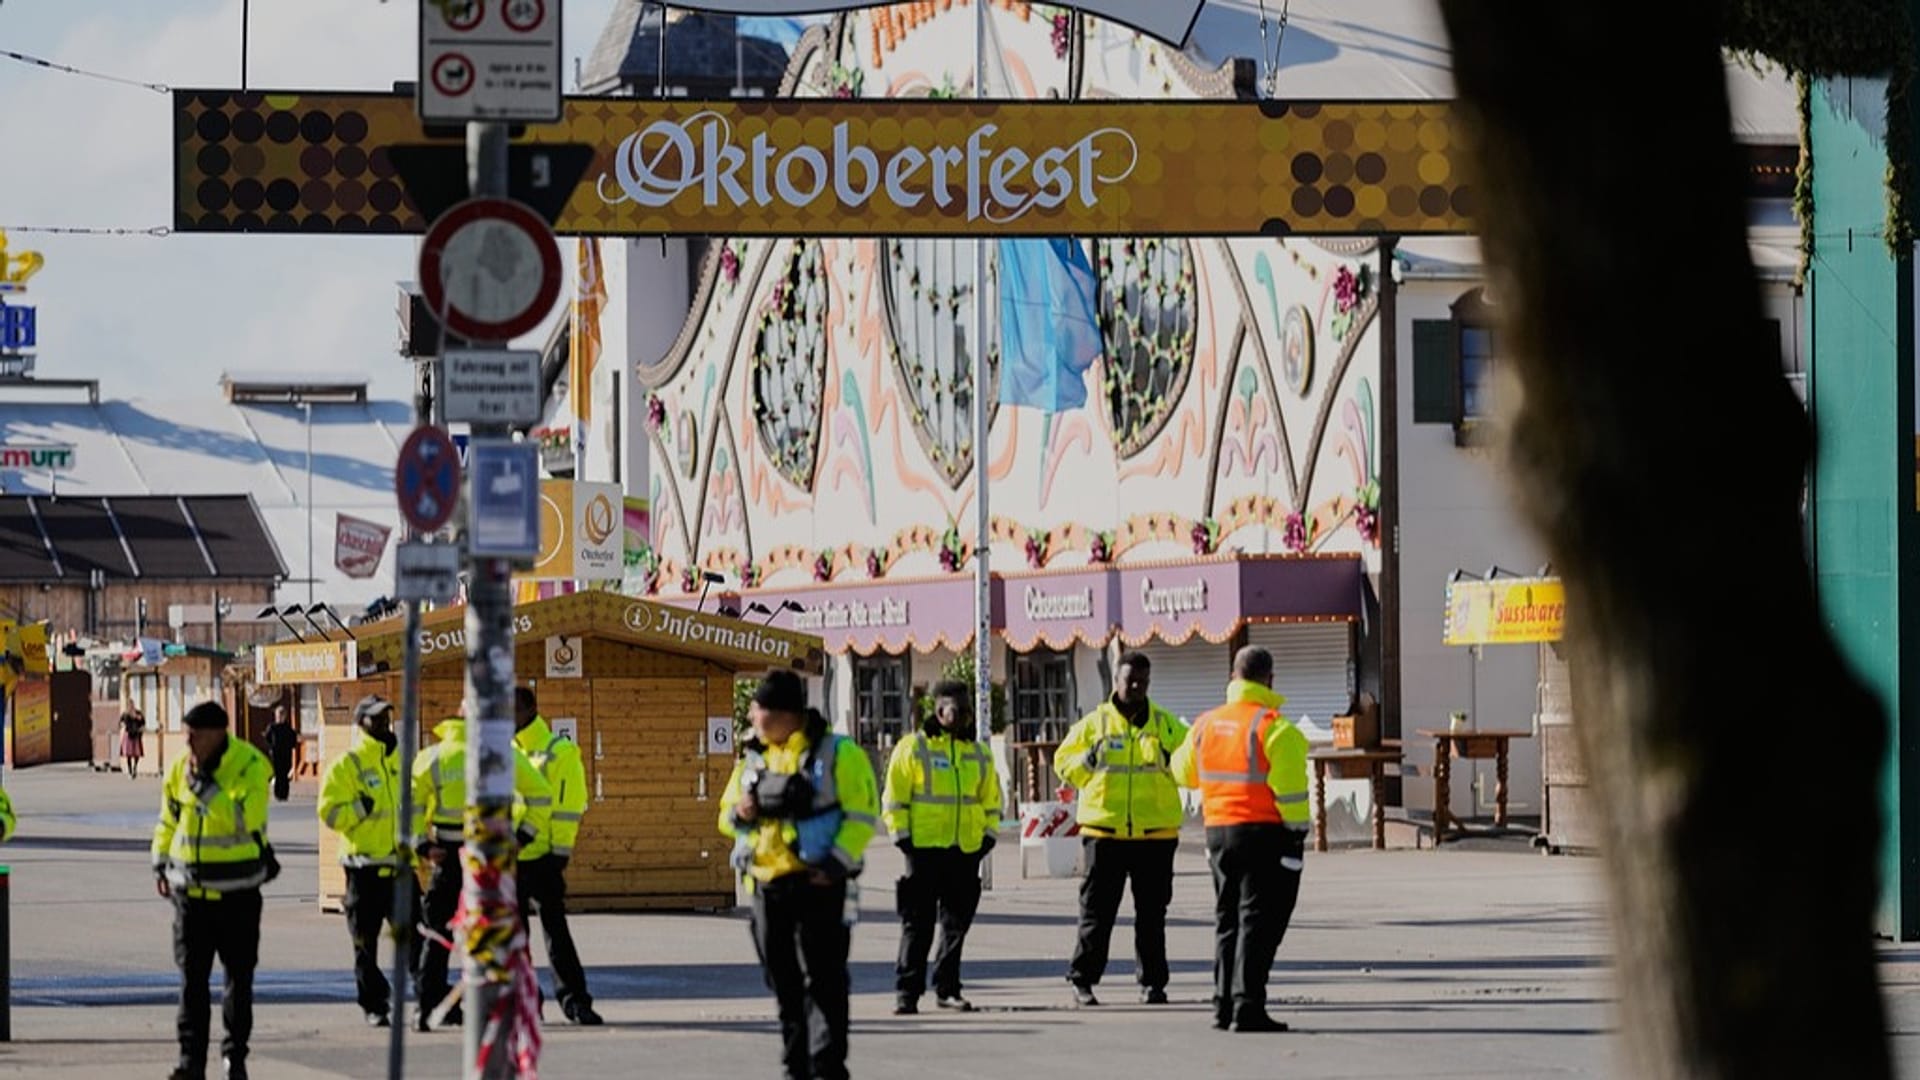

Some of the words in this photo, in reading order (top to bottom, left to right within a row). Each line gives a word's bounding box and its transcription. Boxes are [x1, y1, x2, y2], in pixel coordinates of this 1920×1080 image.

[597, 110, 1138, 224] Oktoberfest
[0, 449, 71, 467] murr
[419, 614, 532, 653] Sours
[655, 609, 790, 658] Information
[714, 727, 728, 744] 6
